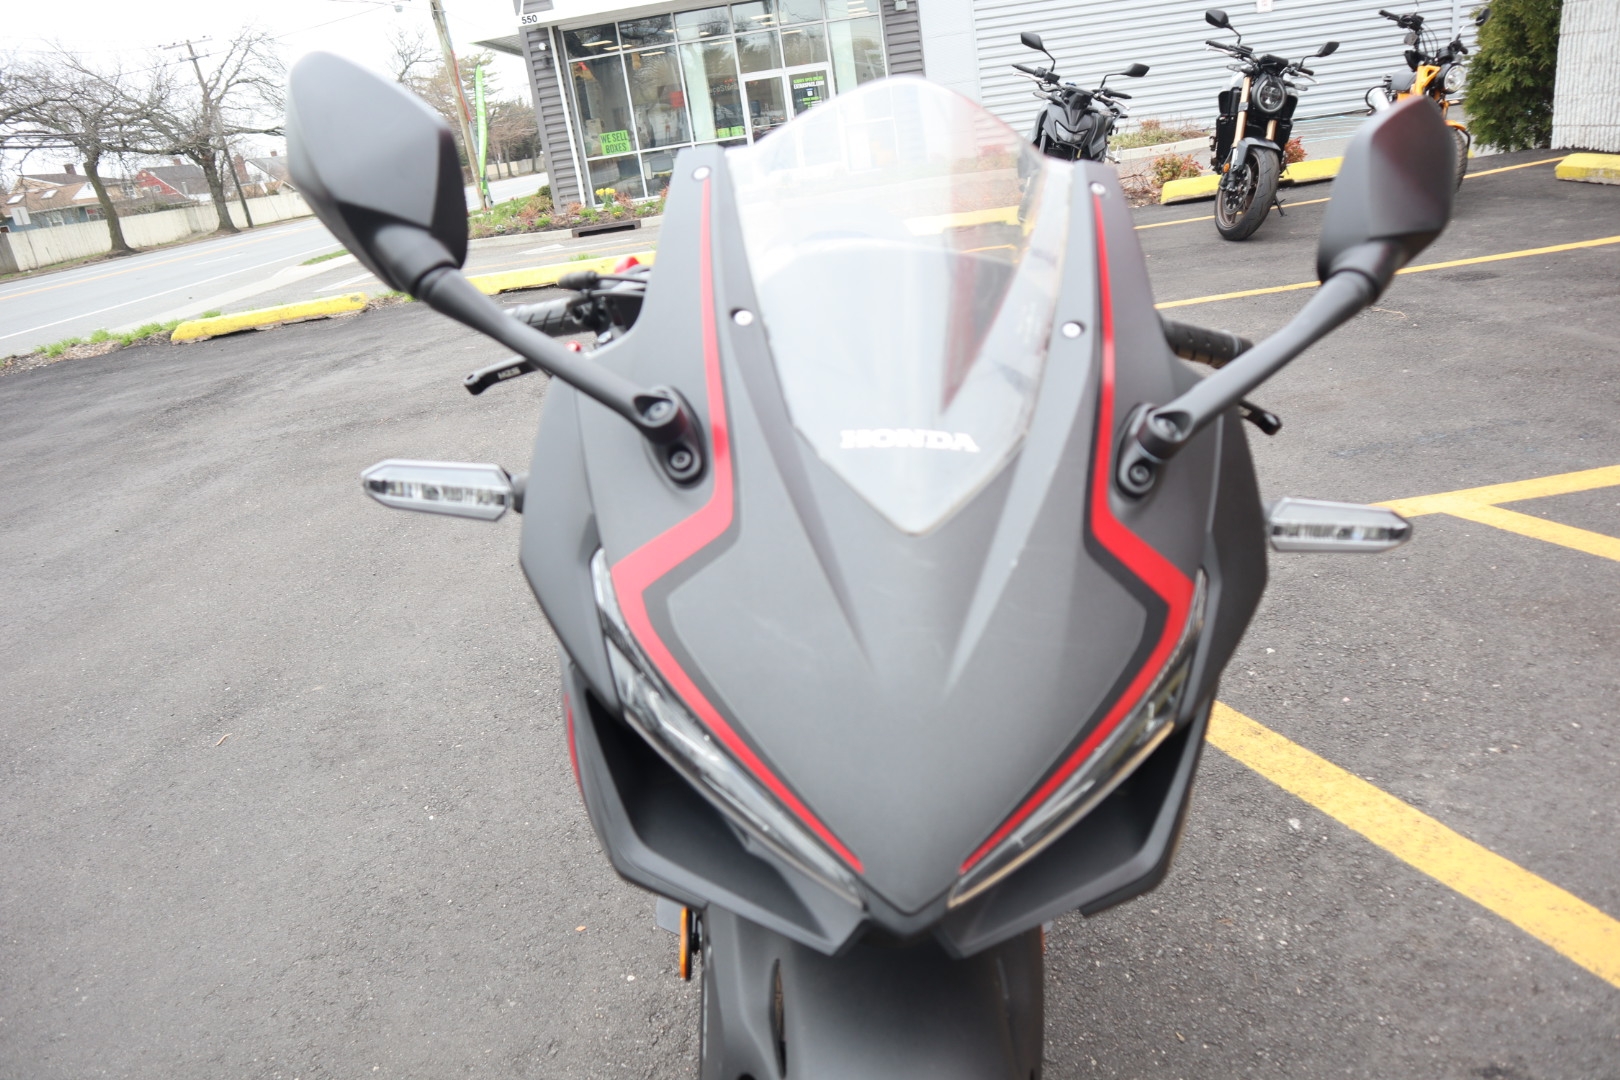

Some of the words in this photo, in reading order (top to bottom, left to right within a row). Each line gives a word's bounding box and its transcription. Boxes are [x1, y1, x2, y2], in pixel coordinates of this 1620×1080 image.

[521, 14, 538, 25] 550
[601, 134, 611, 144] WE
[611, 132, 628, 142] SELL
[605, 142, 627, 154] BOXES
[840, 428, 981, 453] HONDA
